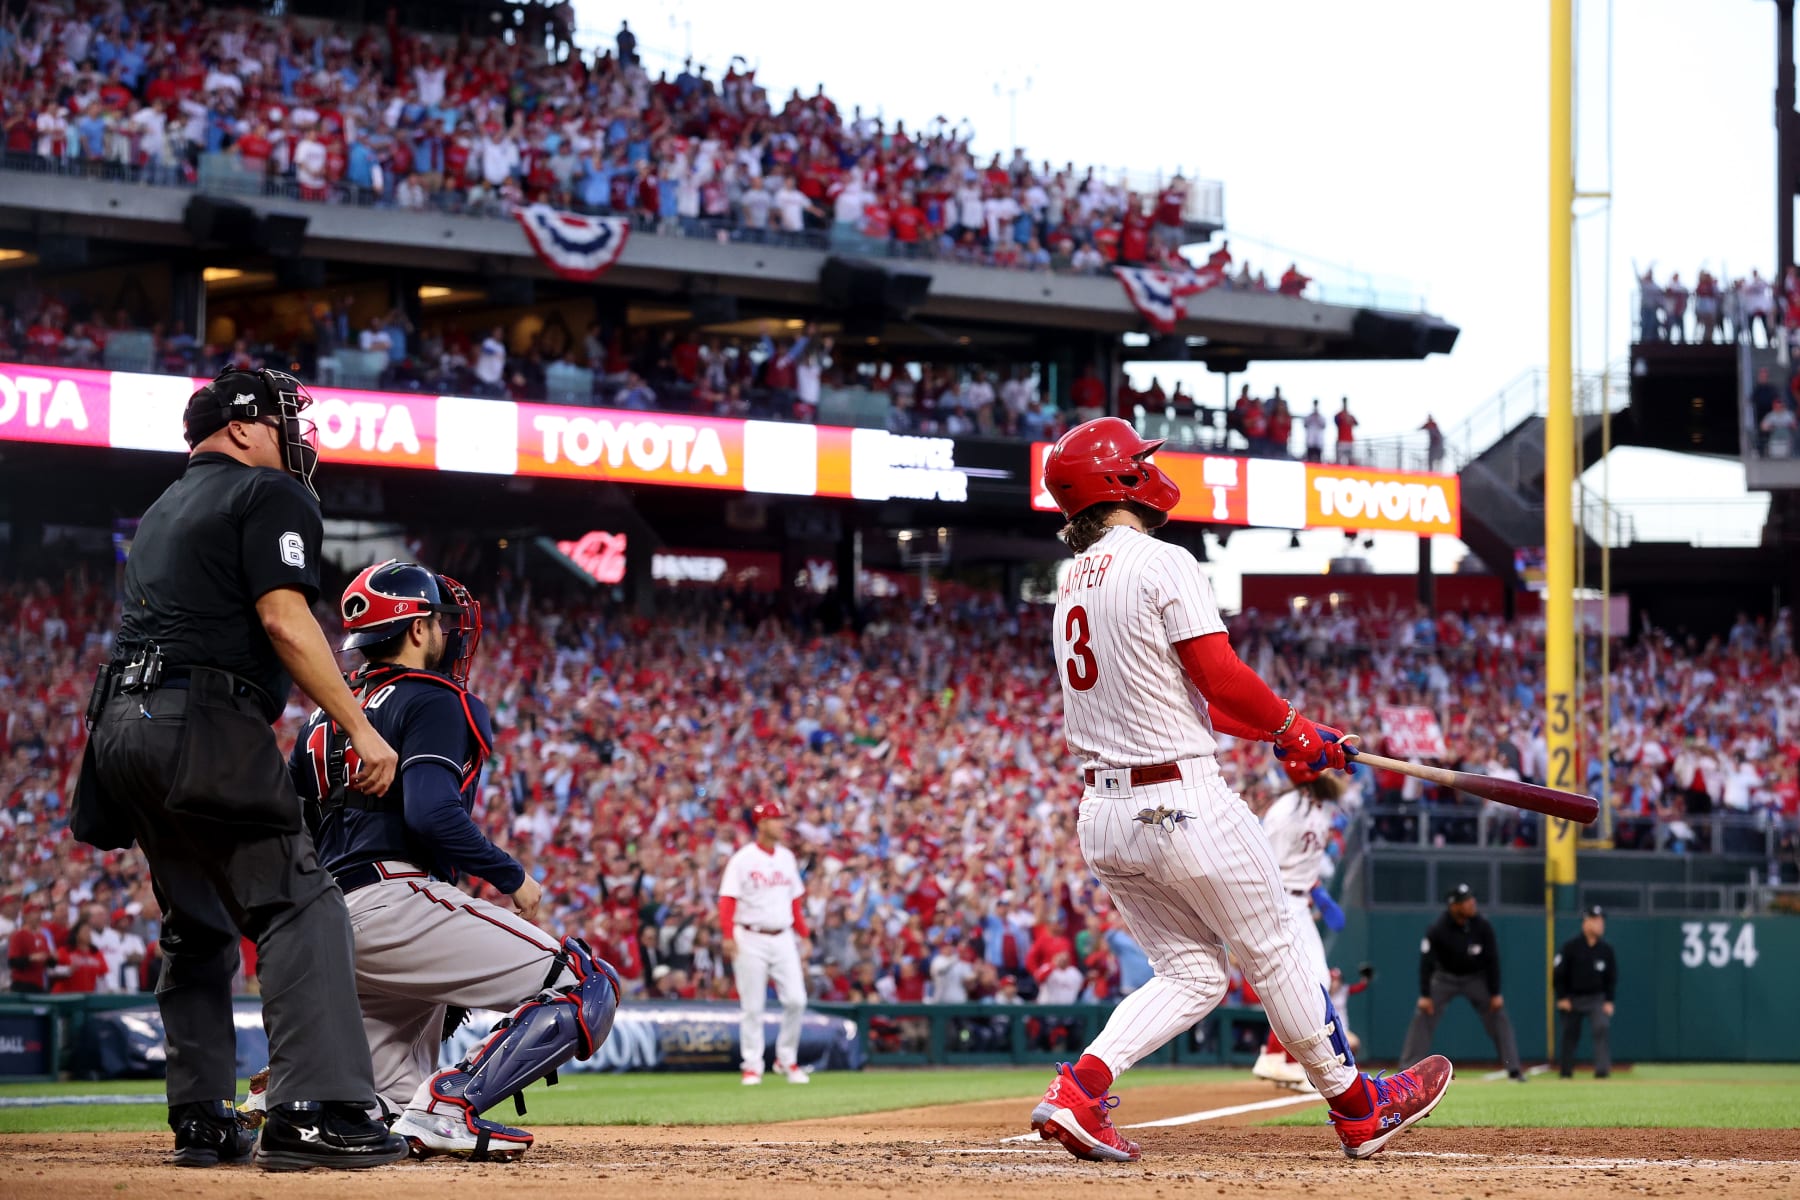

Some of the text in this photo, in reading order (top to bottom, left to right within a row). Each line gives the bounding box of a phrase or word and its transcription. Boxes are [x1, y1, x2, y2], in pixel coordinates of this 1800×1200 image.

[533, 415, 728, 476] TOYOTA
[1313, 476, 1451, 524] TOYOTA
[279, 531, 306, 569] 6
[1065, 605, 1099, 691] 3
[1681, 921, 1760, 968] 334
